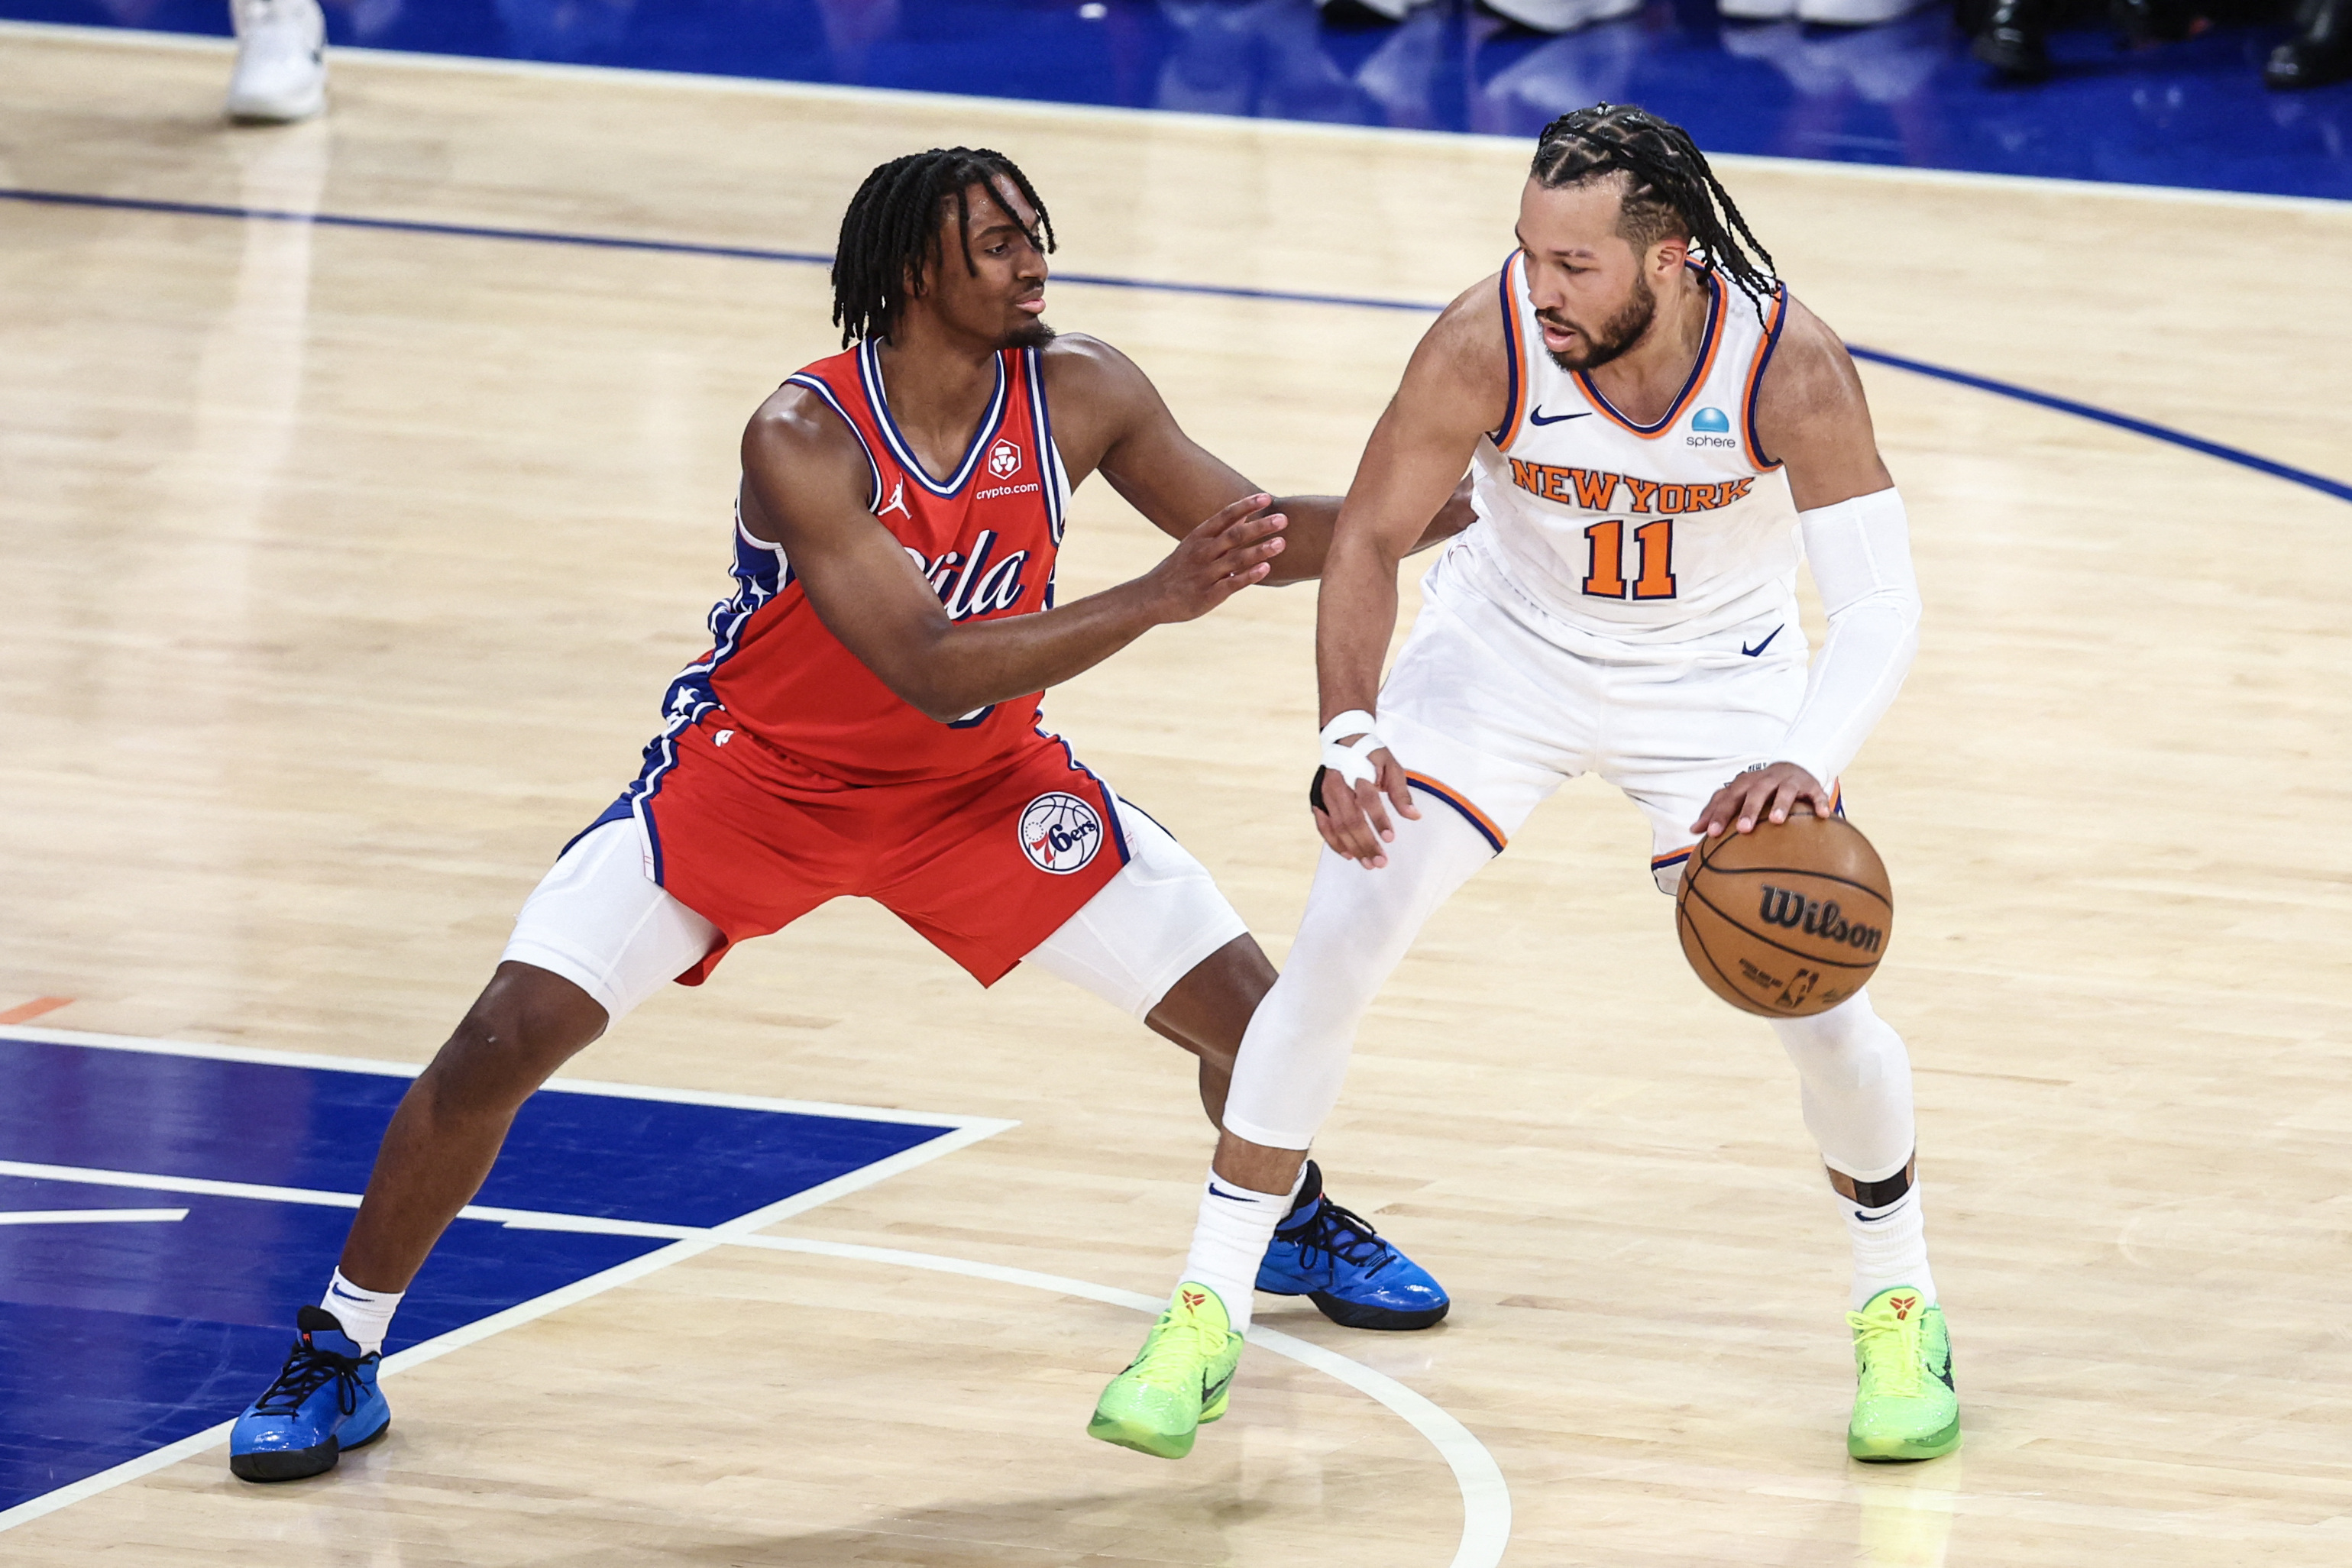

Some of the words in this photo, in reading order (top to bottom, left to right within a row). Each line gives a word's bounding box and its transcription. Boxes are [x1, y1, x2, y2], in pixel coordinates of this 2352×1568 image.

[1686, 435, 1736, 448] sphere
[976, 483, 1039, 499] crypto.com
[1508, 458, 1619, 512] NEW
[1622, 476, 1755, 514] YORK
[1582, 519, 1677, 600] 11
[1760, 884, 1883, 953] Wilson
